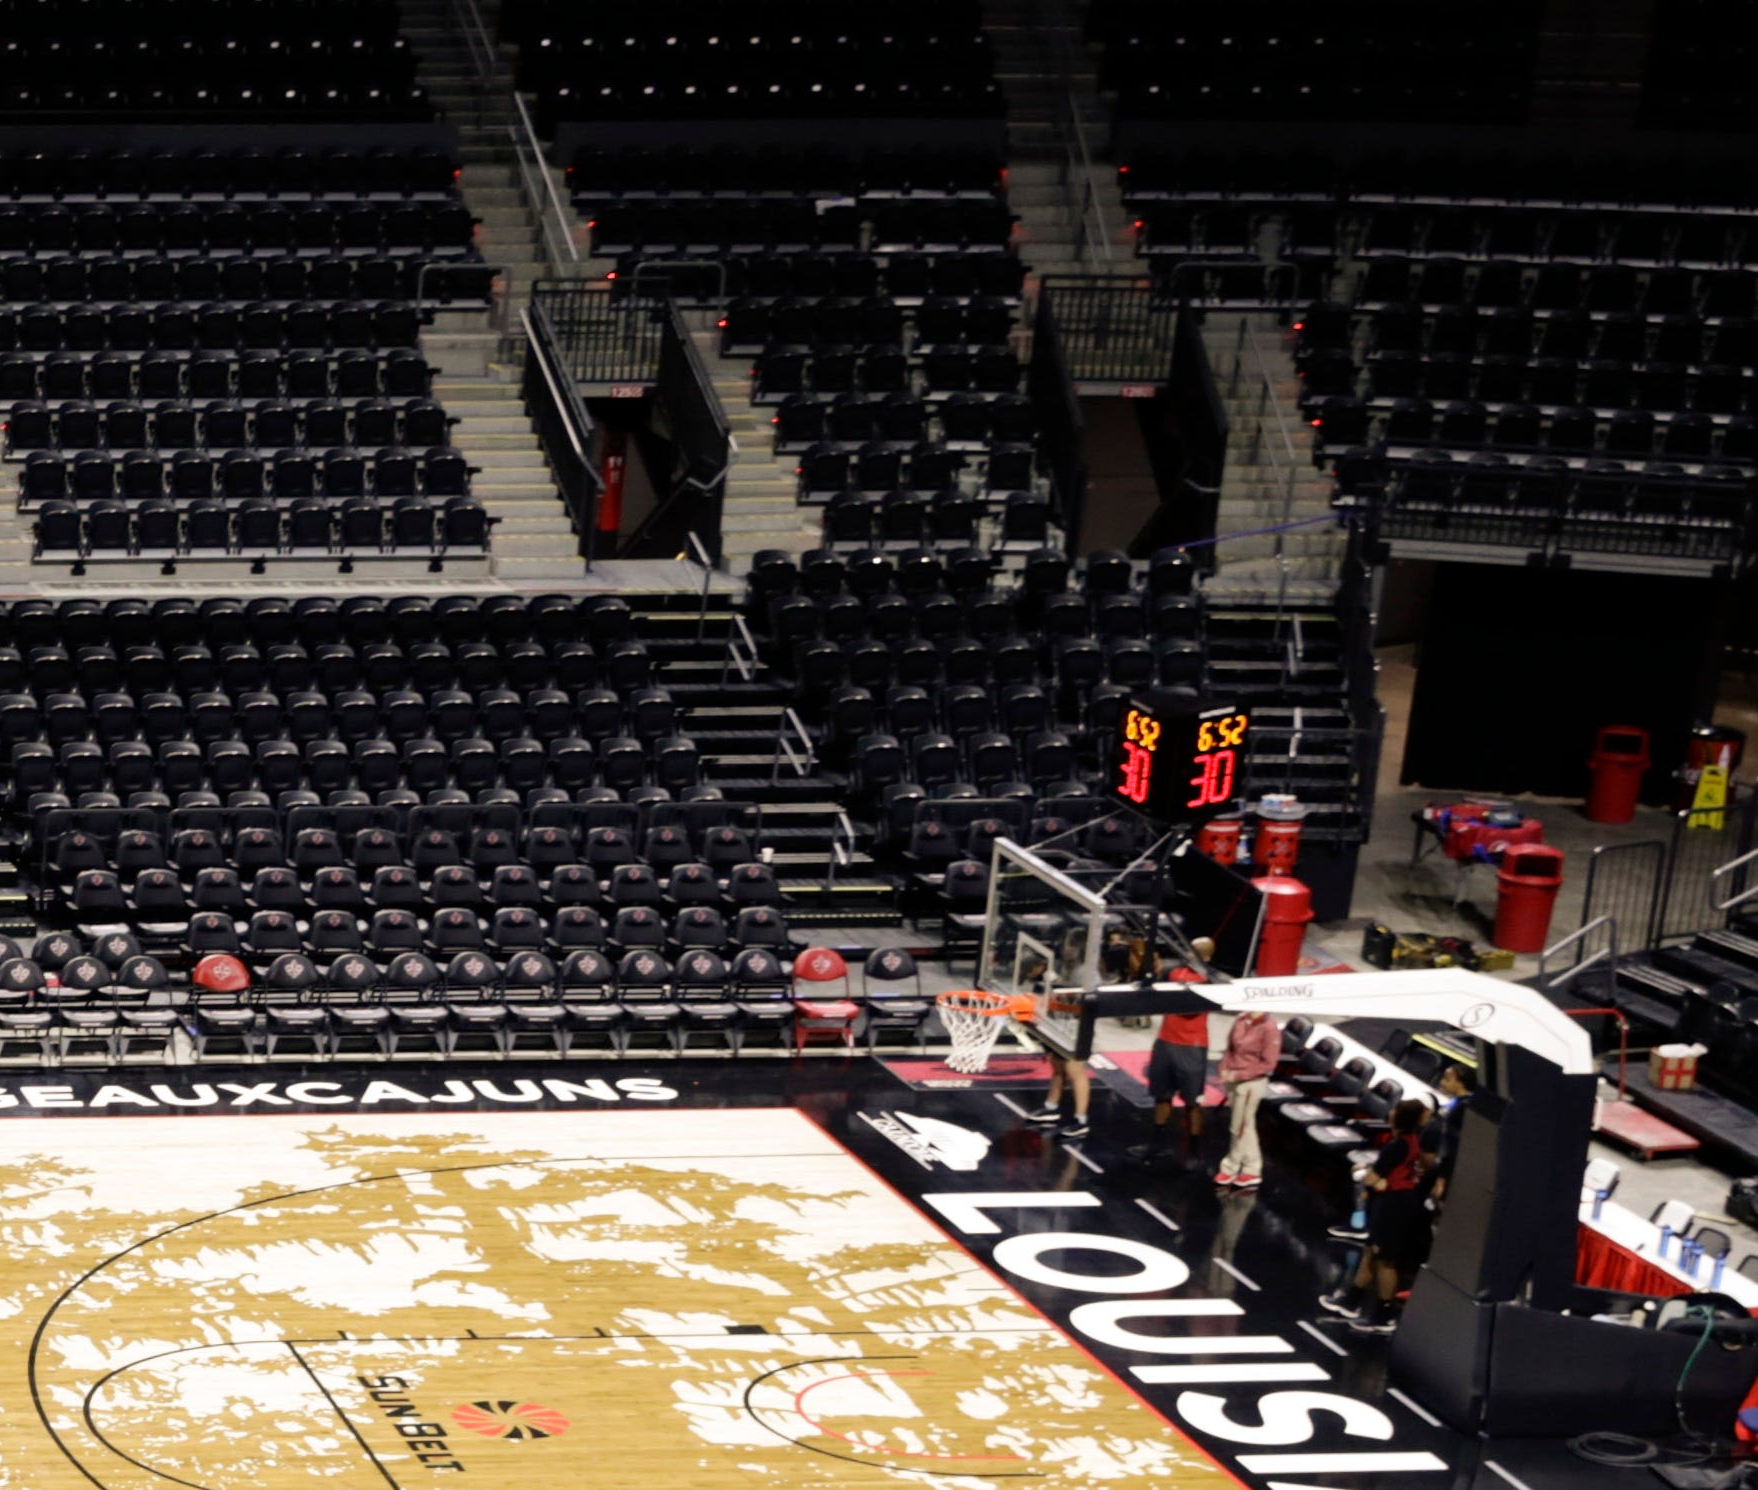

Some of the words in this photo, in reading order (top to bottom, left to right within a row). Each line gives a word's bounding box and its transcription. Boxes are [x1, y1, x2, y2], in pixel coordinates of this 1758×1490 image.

[1198, 715, 1247, 751] 6:52
[1117, 741, 1151, 803] 30
[1187, 750, 1235, 808] 30
[1244, 982, 1314, 1000] SPALDING
[356, 1375, 422, 1418] SUN
[393, 1423, 465, 1472] BELT
